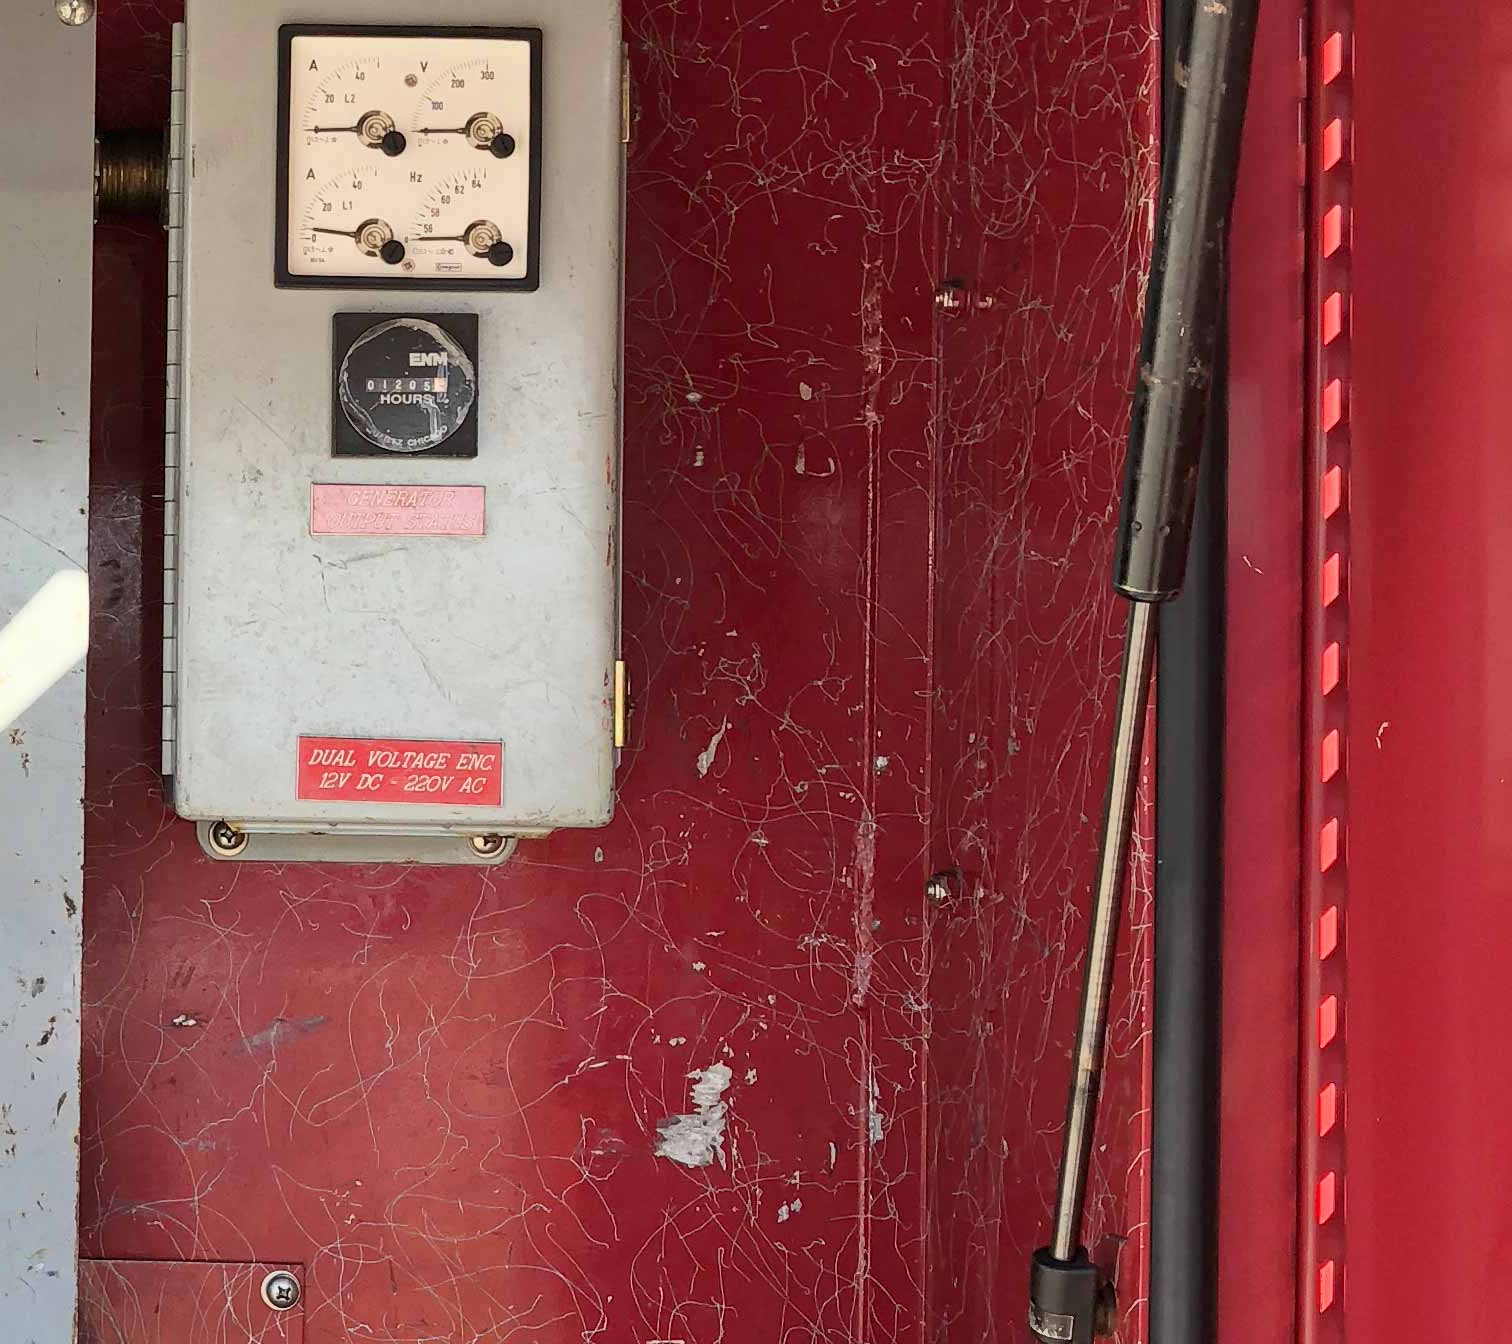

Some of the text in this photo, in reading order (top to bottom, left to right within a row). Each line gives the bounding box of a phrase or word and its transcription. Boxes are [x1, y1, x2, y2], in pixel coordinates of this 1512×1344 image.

[309, 60, 318, 71] A
[420, 62, 428, 72] V
[355, 72, 365, 81] 40
[481, 72, 494, 80] 300
[451, 79, 465, 88] 200
[324, 94, 334, 103] 20
[345, 94, 355, 103] L2
[432, 102, 443, 110] 100
[306, 168, 315, 180] A
[410, 172, 422, 183] Hz
[352, 181, 362, 190] 40
[472, 180, 482, 188] 64
[454, 185, 464, 194] 62
[441, 196, 450, 205] 60
[322, 202, 332, 212] 20
[343, 201, 353, 210] L1
[431, 208, 440, 217] 58
[424, 224, 433, 233] 56
[409, 351, 448, 367] ENM
[380, 393, 433, 405] HOURS
[346, 489, 457, 508] GENERATOR
[325, 510, 399, 531] OUTPUT
[308, 749, 357, 767] DUAL
[367, 750, 451, 770] VOLTAGE
[319, 772, 352, 789] 12V
[356, 773, 385, 791] DC
[403, 775, 455, 793] 220V
[458, 777, 487, 794] AC
